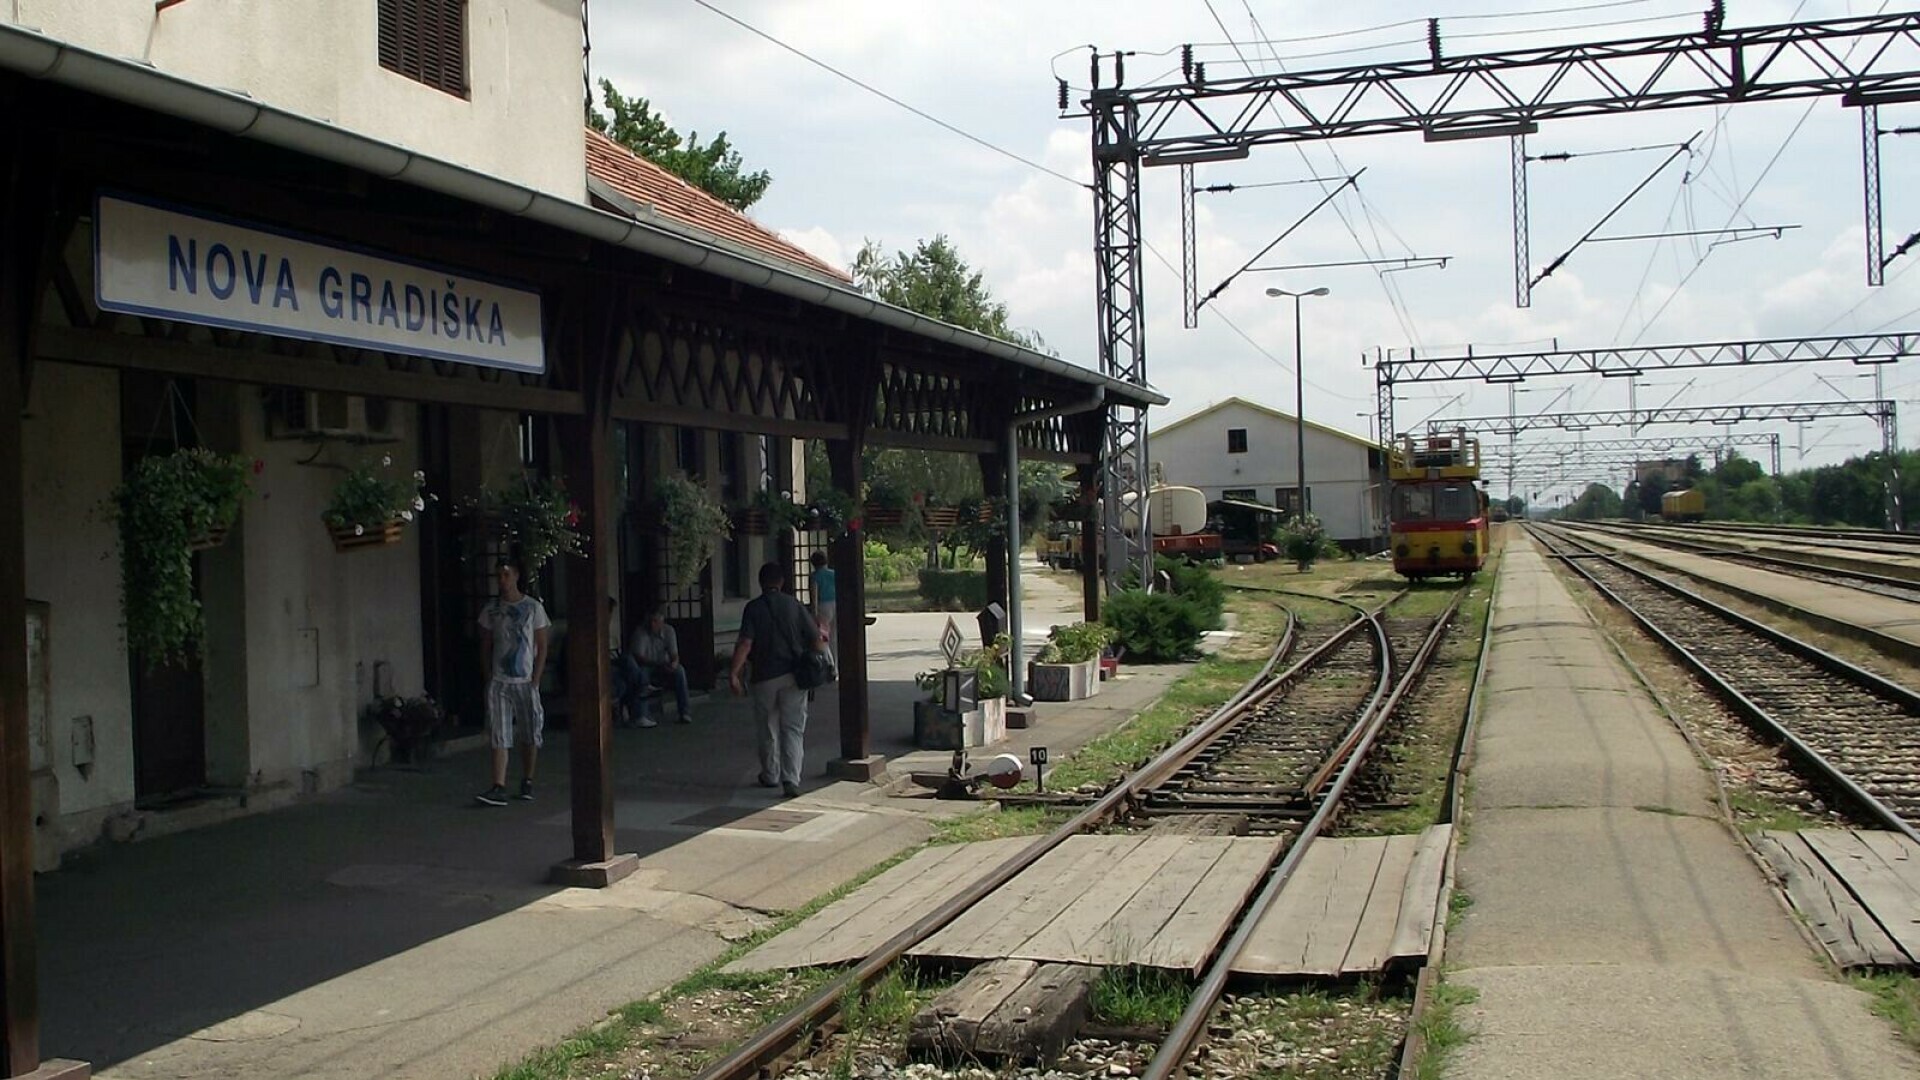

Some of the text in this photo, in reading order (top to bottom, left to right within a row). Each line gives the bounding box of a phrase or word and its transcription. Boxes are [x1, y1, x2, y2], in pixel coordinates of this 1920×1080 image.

[168, 235, 507, 347] NOVA GRADIŠKA
[1031, 749, 1046, 761] 10
